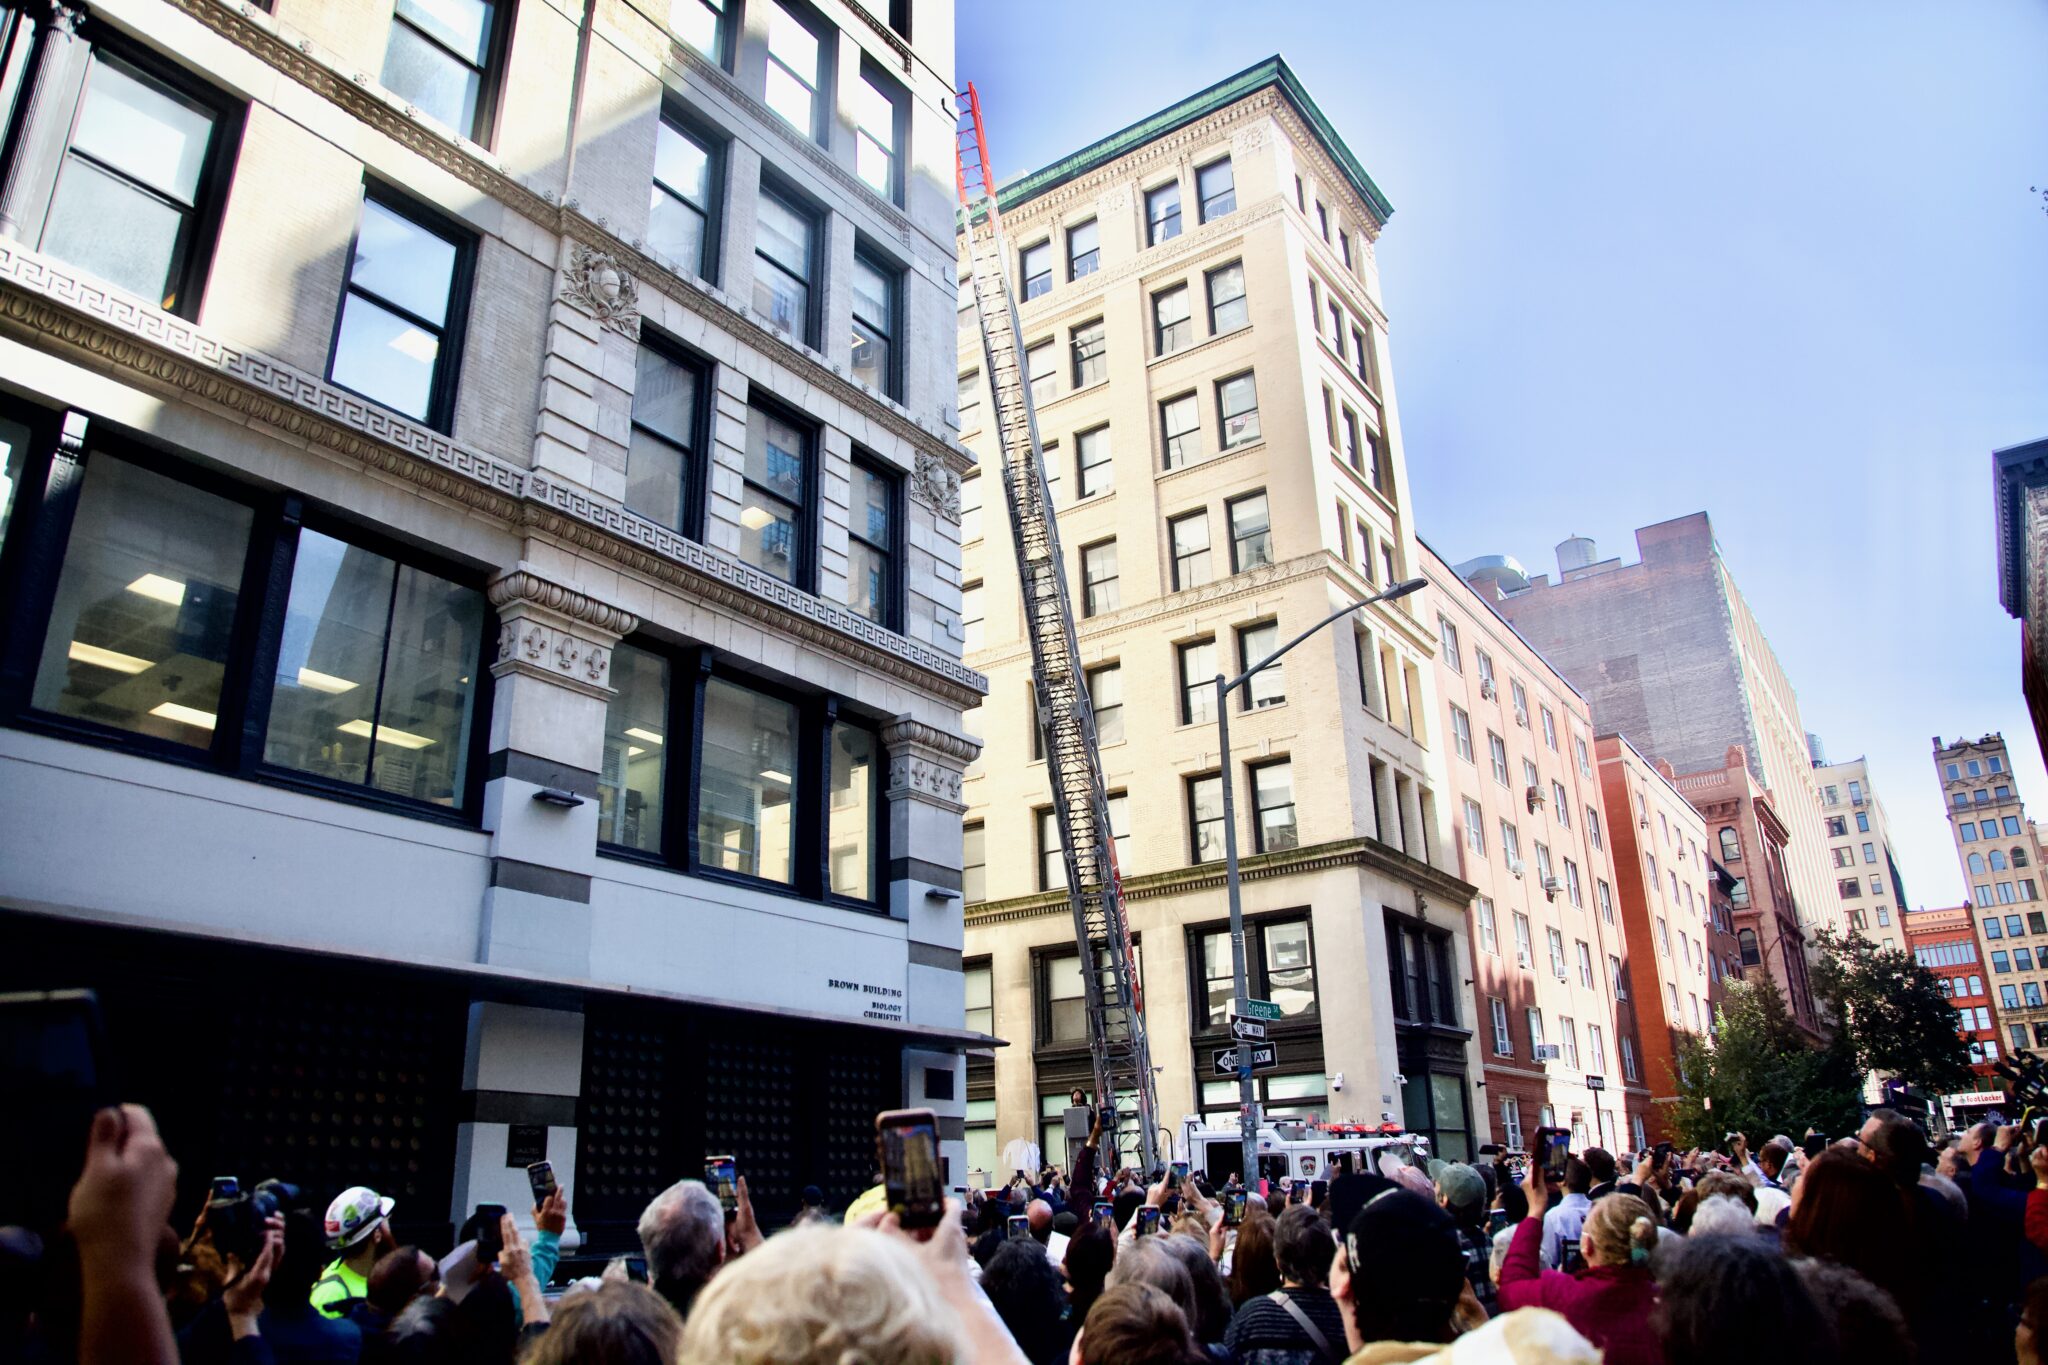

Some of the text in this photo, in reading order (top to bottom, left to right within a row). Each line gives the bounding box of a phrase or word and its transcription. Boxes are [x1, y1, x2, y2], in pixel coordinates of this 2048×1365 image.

[1112, 864, 1132, 947] LADDER
[828, 979, 902, 998] BROWN BUILDING
[872, 1001, 902, 1012] BIOLOGY
[1247, 1001, 1271, 1018] Greene
[863, 1010, 902, 1022] CHEMISTRY
[1236, 1023, 1263, 1035] ONE WAY
[1222, 1055, 1239, 1067] ONE
